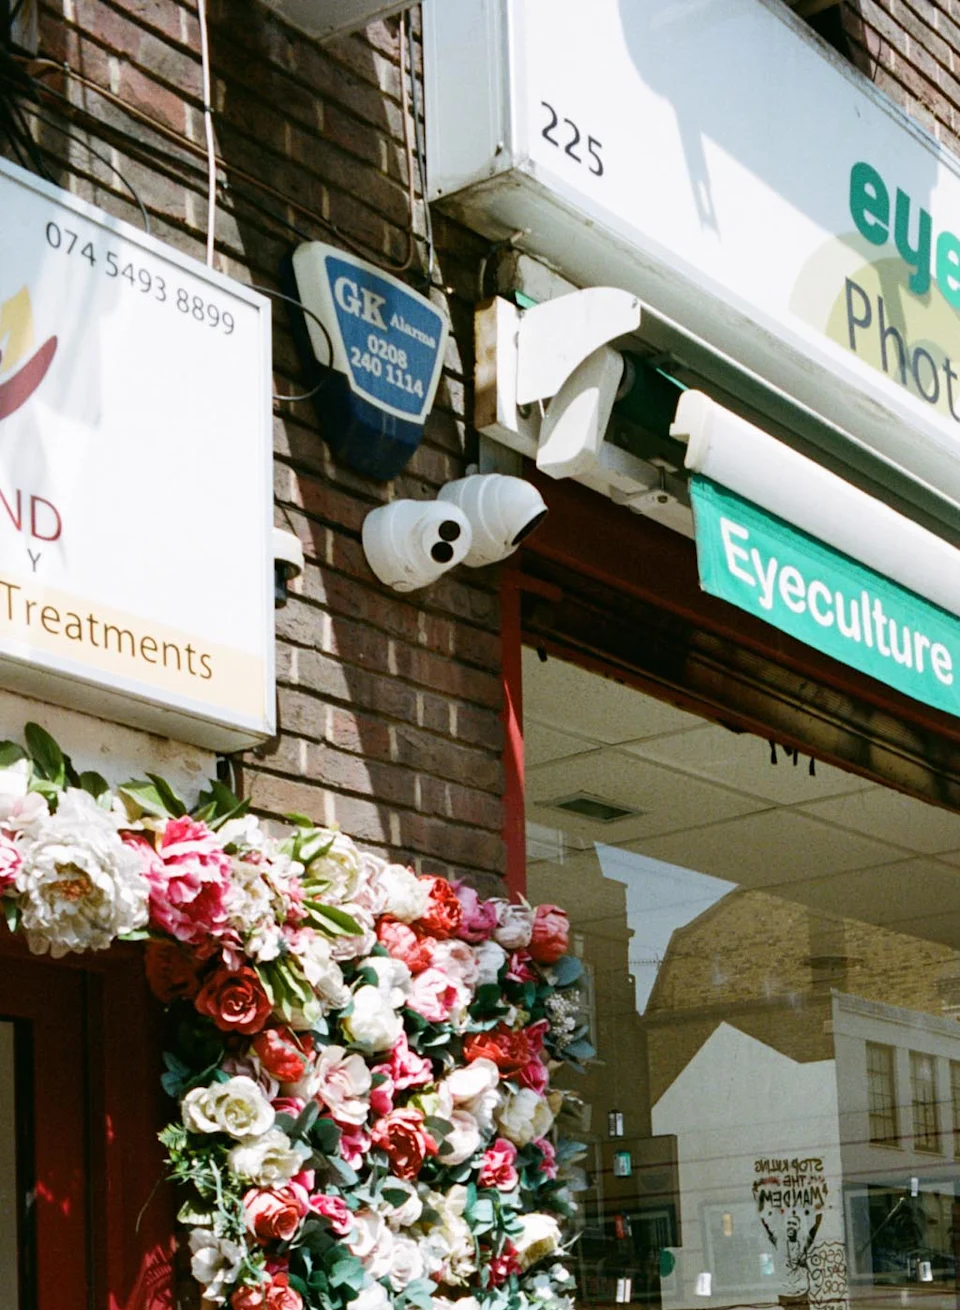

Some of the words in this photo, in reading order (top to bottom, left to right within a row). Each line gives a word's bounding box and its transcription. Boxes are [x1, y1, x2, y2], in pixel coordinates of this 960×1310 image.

[541, 100, 604, 177] 225
[45, 221, 97, 267] 074
[106, 251, 167, 302] 5493
[176, 288, 235, 335] 8899
[334, 276, 388, 332] GK
[390, 312, 436, 349] Alarms
[350, 346, 382, 377] 240
[386, 365, 424, 399] 1114
[367, 333, 408, 370] 0208
[0, 580, 213, 680] Treatments
[720, 516, 954, 687] Eyeculture
